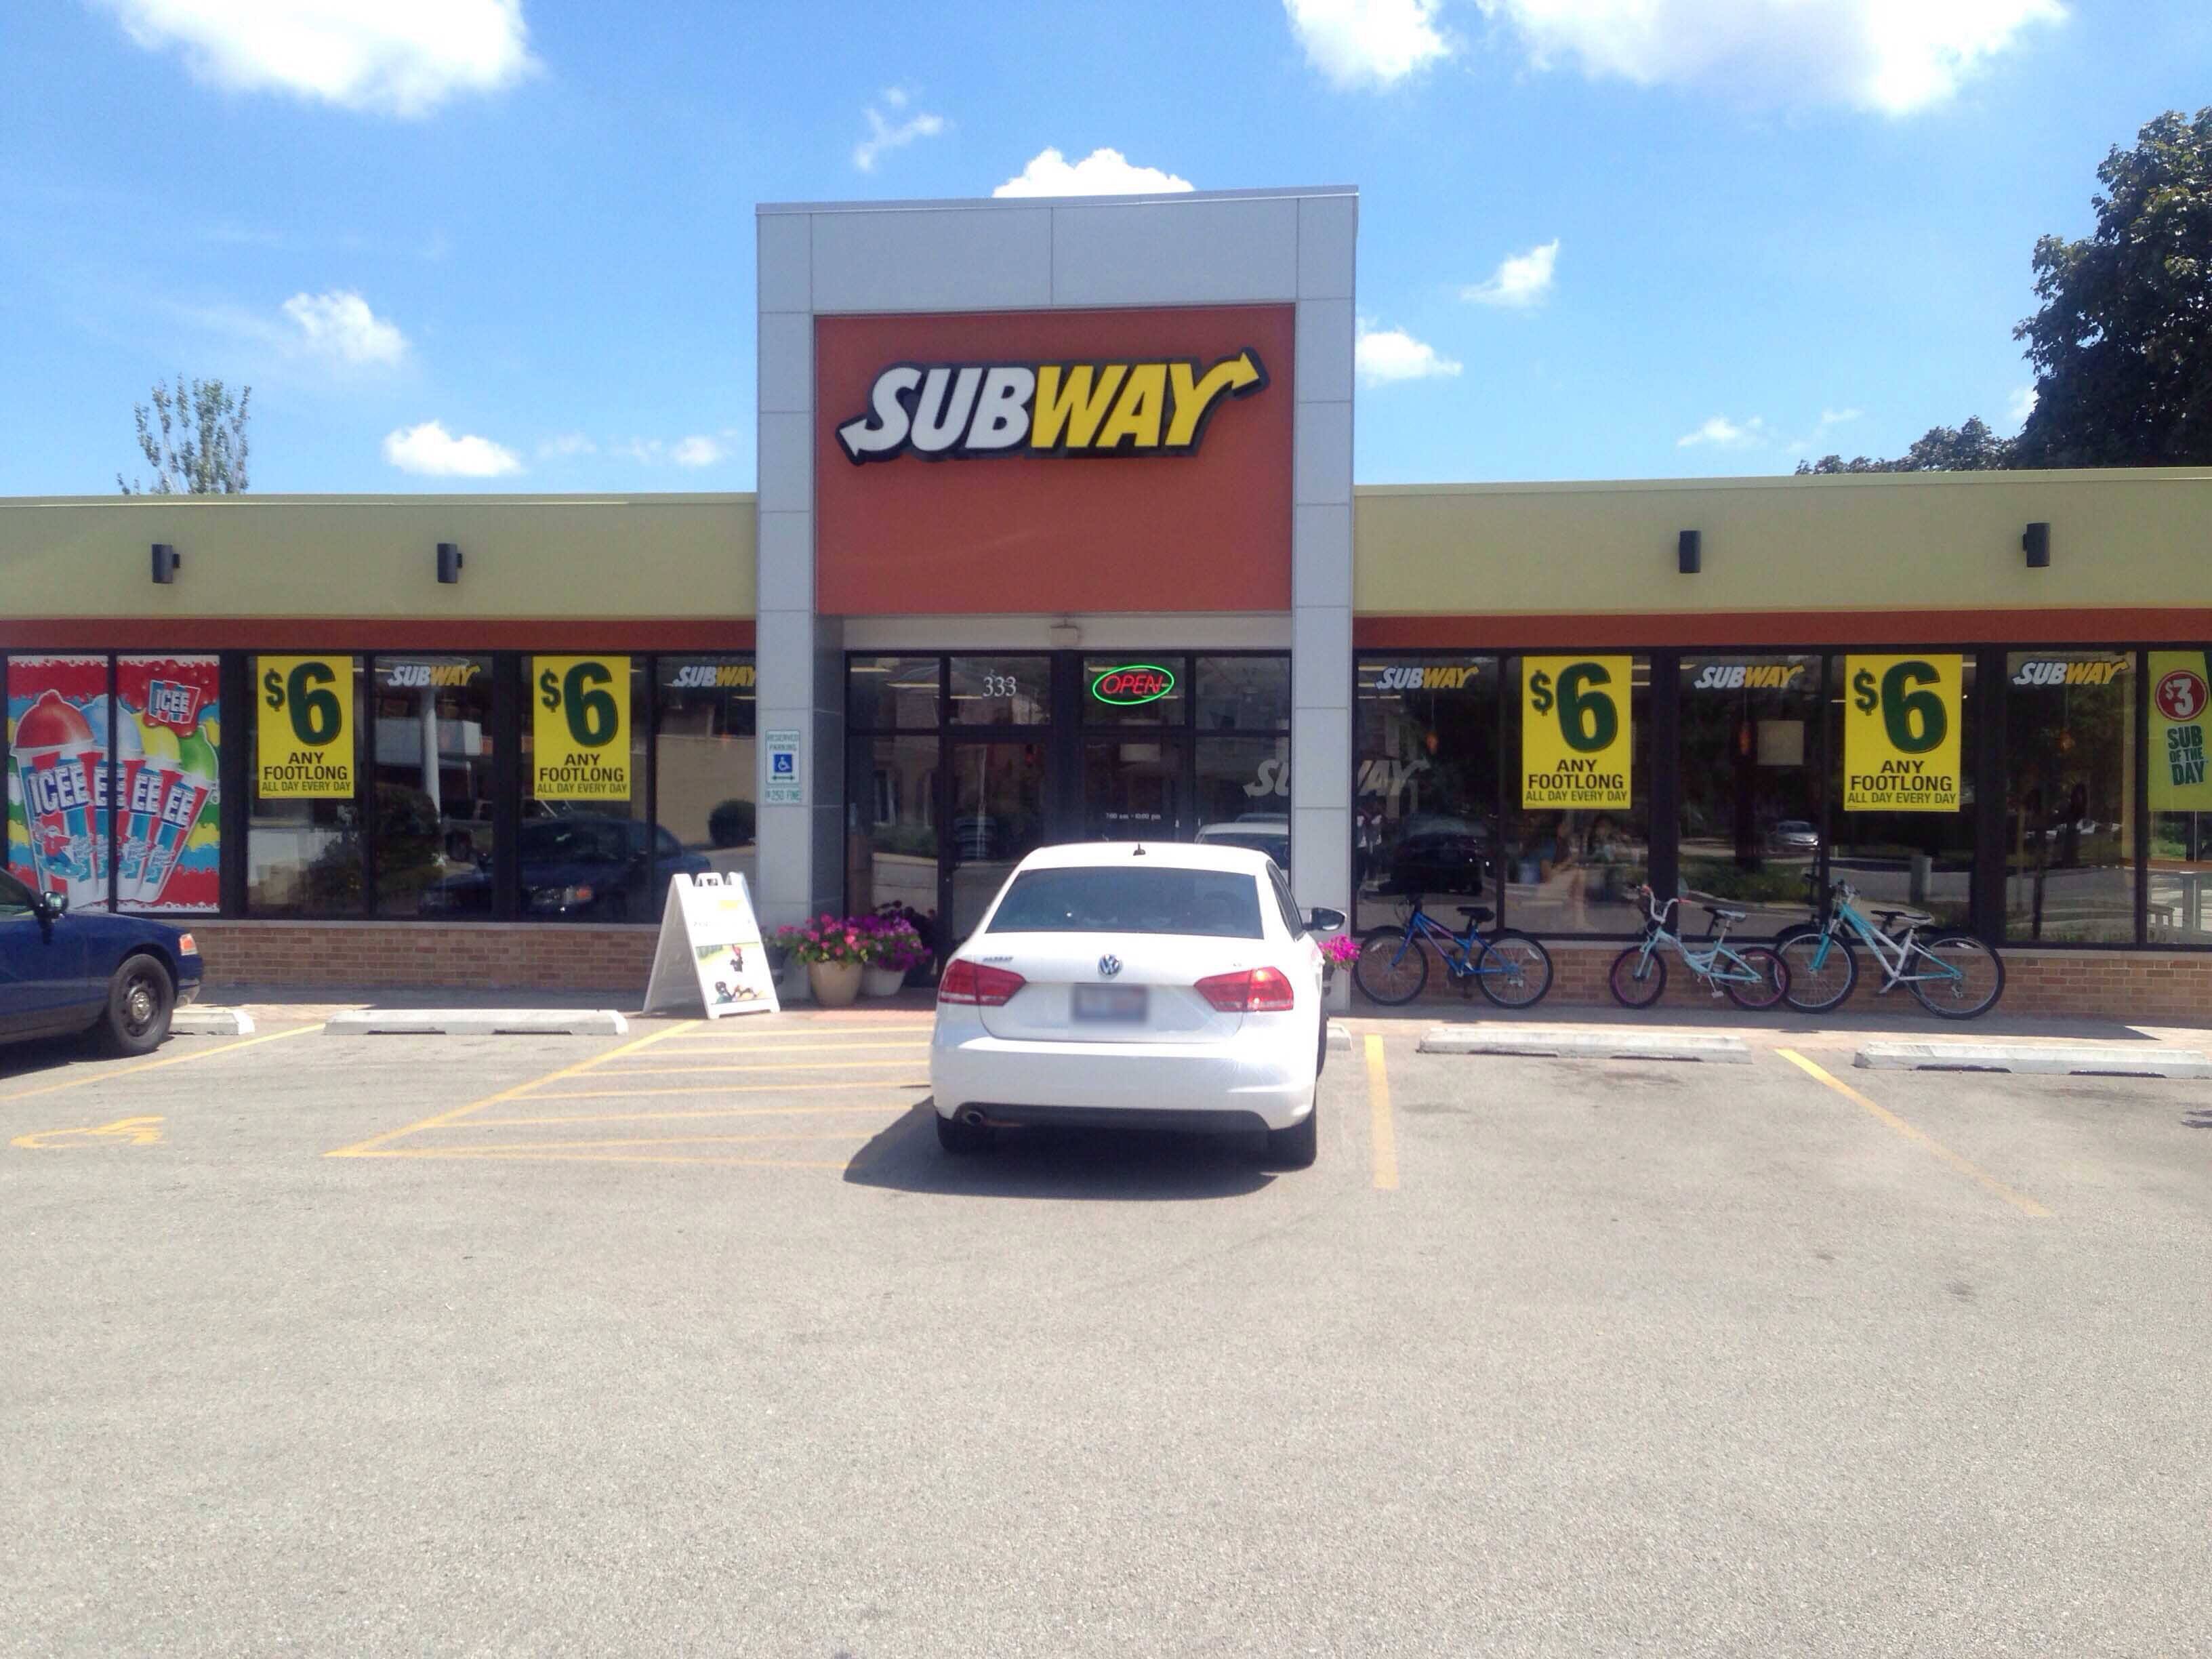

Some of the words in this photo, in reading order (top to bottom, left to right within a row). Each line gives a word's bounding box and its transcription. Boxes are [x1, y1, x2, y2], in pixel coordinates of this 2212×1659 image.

[839, 351, 1260, 457] SUBWAY
[387, 665, 480, 687] SUBWAY
[1376, 665, 1479, 689] SUBWAY
[1694, 664, 1805, 689] SUBWAY
[2011, 660, 2129, 685] SUBWAY
[983, 676, 1017, 697] 333
[1102, 674, 1163, 695] OPEN
[156, 689, 190, 714] ICEE
[263, 661, 342, 747] $6
[539, 661, 619, 748] $6
[1530, 661, 1618, 754] $6
[1853, 660, 1948, 754] $6
[2165, 678, 2194, 716] $3
[2167, 724, 2203, 750] SUB
[289, 752, 325, 765] ANY
[564, 753, 600, 766] ANY
[2169, 750, 2182, 762] OF
[2183, 747, 2204, 761] THE
[264, 766, 348, 780] FOOTLONG
[539, 767, 624, 782] FOOTLONG
[1556, 759, 1597, 772] ANY
[1881, 760, 1925, 774] ANY
[2171, 760, 2205, 786] DAY
[28, 762, 90, 815] ICEE
[262, 781, 279, 792] ALL
[281, 781, 299, 792] DAY
[302, 781, 331, 792] EVERY
[333, 781, 352, 792] DAY
[537, 783, 554, 794] ALL
[557, 783, 574, 794] DAY
[577, 783, 607, 794] EVERY
[609, 783, 628, 794] DAY
[1528, 774, 1624, 790] FOOTLONG
[1851, 775, 1952, 791] FOOTLONG
[1525, 790, 1544, 802] ALL
[1548, 790, 1568, 802] DAY
[1571, 790, 1604, 802] EVERY
[1607, 790, 1627, 802] DAY
[1847, 792, 1867, 804] ALL
[1871, 792, 1893, 804] DAY
[1896, 792, 1931, 804] EVERY
[1934, 792, 1957, 804] DAY
